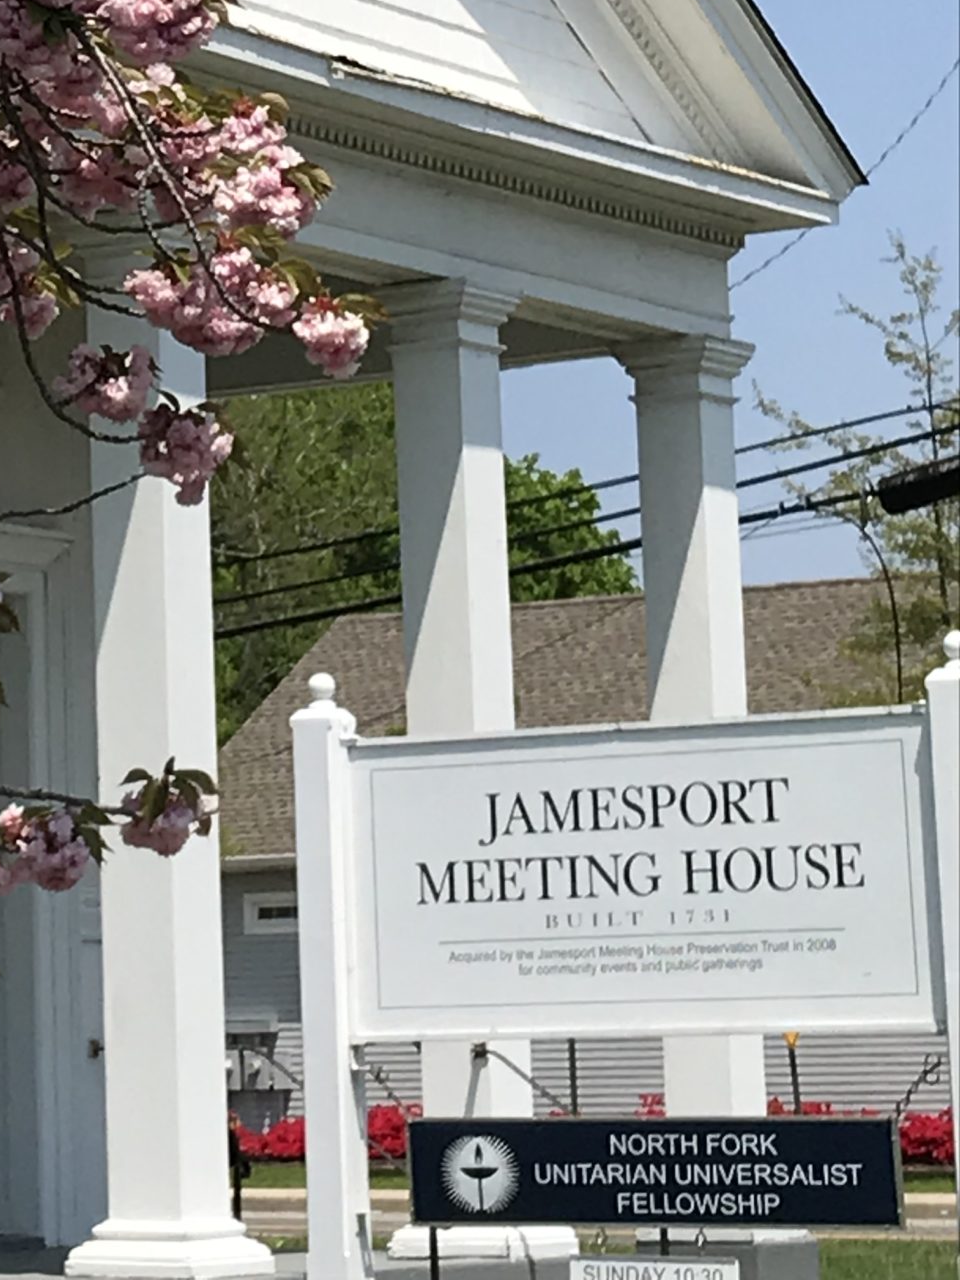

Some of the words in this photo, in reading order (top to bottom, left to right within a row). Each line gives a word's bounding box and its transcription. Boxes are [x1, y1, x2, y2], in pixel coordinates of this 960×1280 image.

[478, 777, 790, 847] JAMESPORT
[415, 851, 663, 906] MEETING
[680, 842, 866, 895] HOUSE
[544, 911, 643, 930] BUILT
[669, 908, 731, 926] 1731
[448, 949, 498, 965] Acquired
[499, 949, 514, 963] by
[516, 948, 535, 961] the
[537, 945, 597, 963] Jamesport
[598, 943, 644, 960] Meeting
[646, 943, 684, 957] House
[686, 940, 759, 956] Preservation
[760, 939, 791, 954] Trust
[792, 939, 804, 953] in
[806, 937, 837, 953] 2008
[518, 963, 535, 977] for
[536, 960, 597, 978] community
[599, 960, 639, 975] events
[641, 958, 663, 973] and
[665, 957, 701, 975] public
[702, 956, 764, 974] gatherings
[609, 1133, 699, 1156] NORTH
[706, 1133, 778, 1156] FORK
[534, 1163, 667, 1185] UNITARIAN
[674, 1163, 863, 1186] UNIVERSALIST
[617, 1192, 781, 1216] FELLOWSHIP
[582, 1264, 666, 1280] SUNDAY
